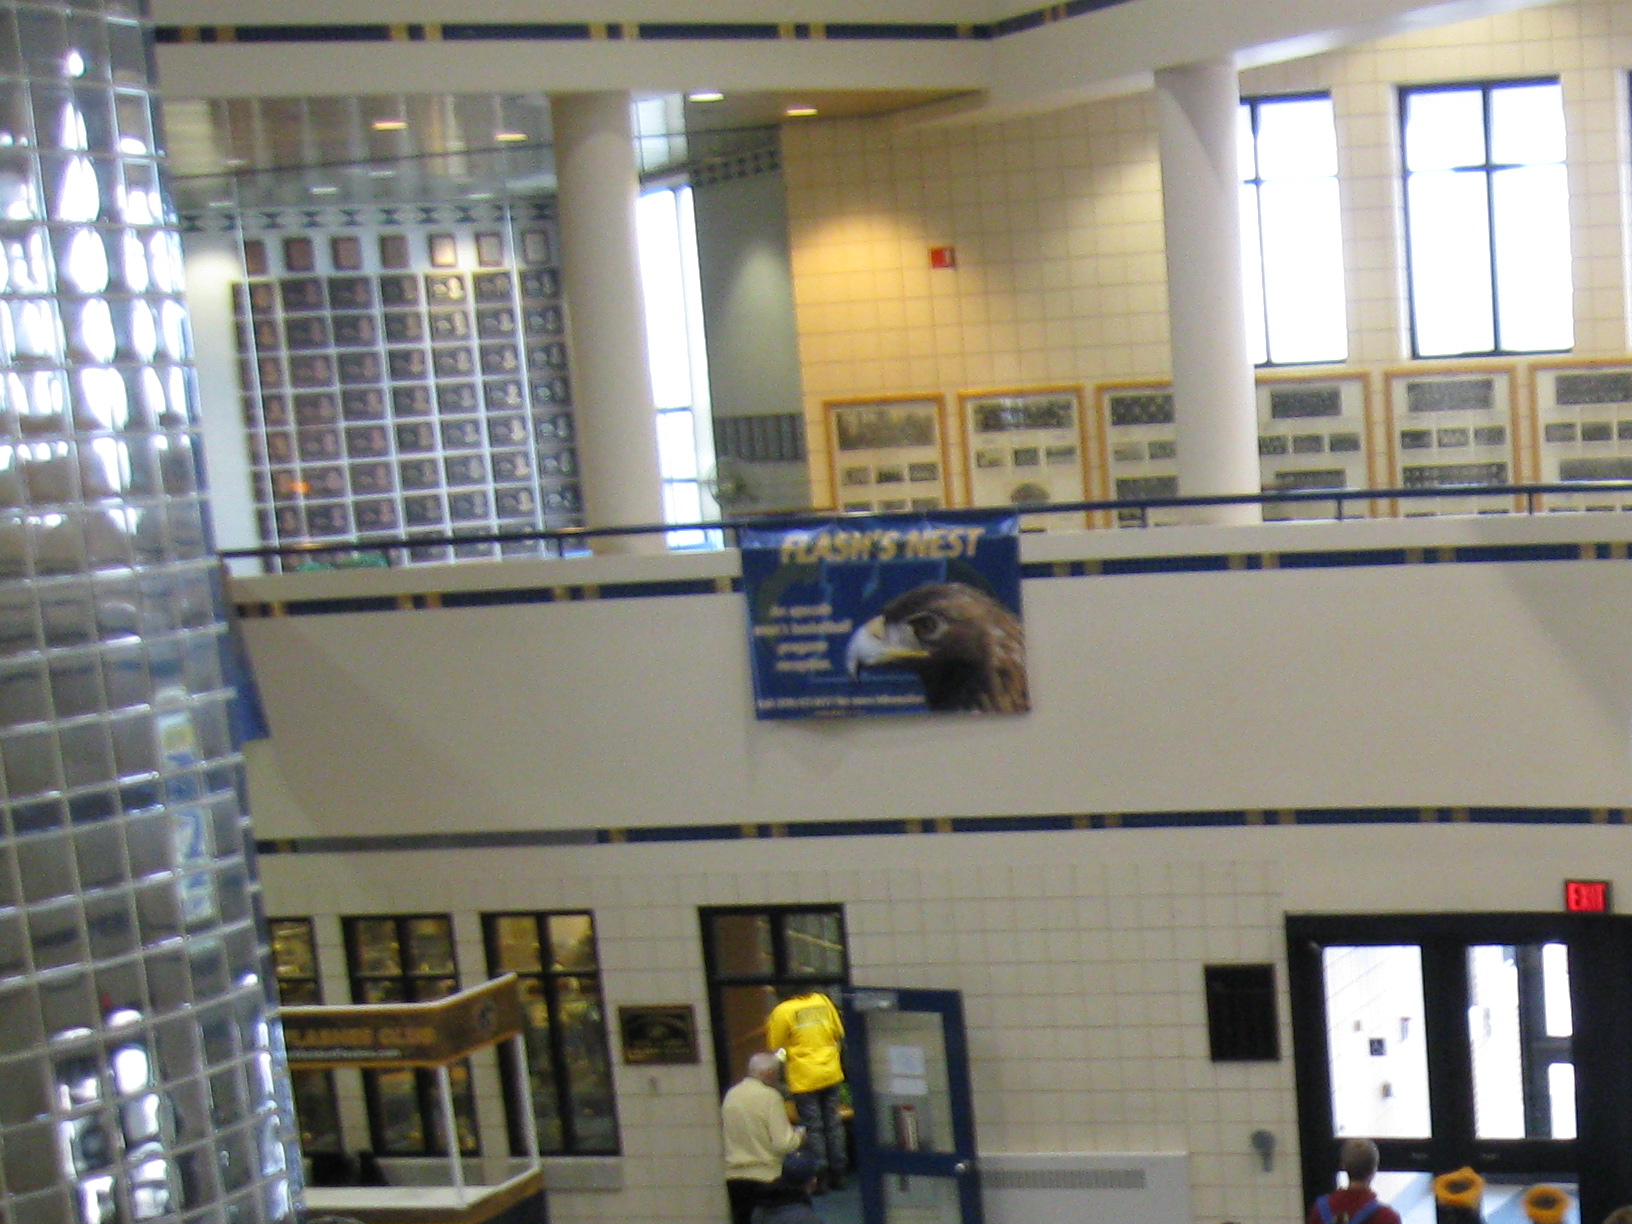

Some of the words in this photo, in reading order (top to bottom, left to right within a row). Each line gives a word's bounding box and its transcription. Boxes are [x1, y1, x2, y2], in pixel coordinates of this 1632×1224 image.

[780, 529, 900, 564] FLASH'S
[904, 526, 986, 559] NEST
[1567, 882, 1606, 912] EXIT
